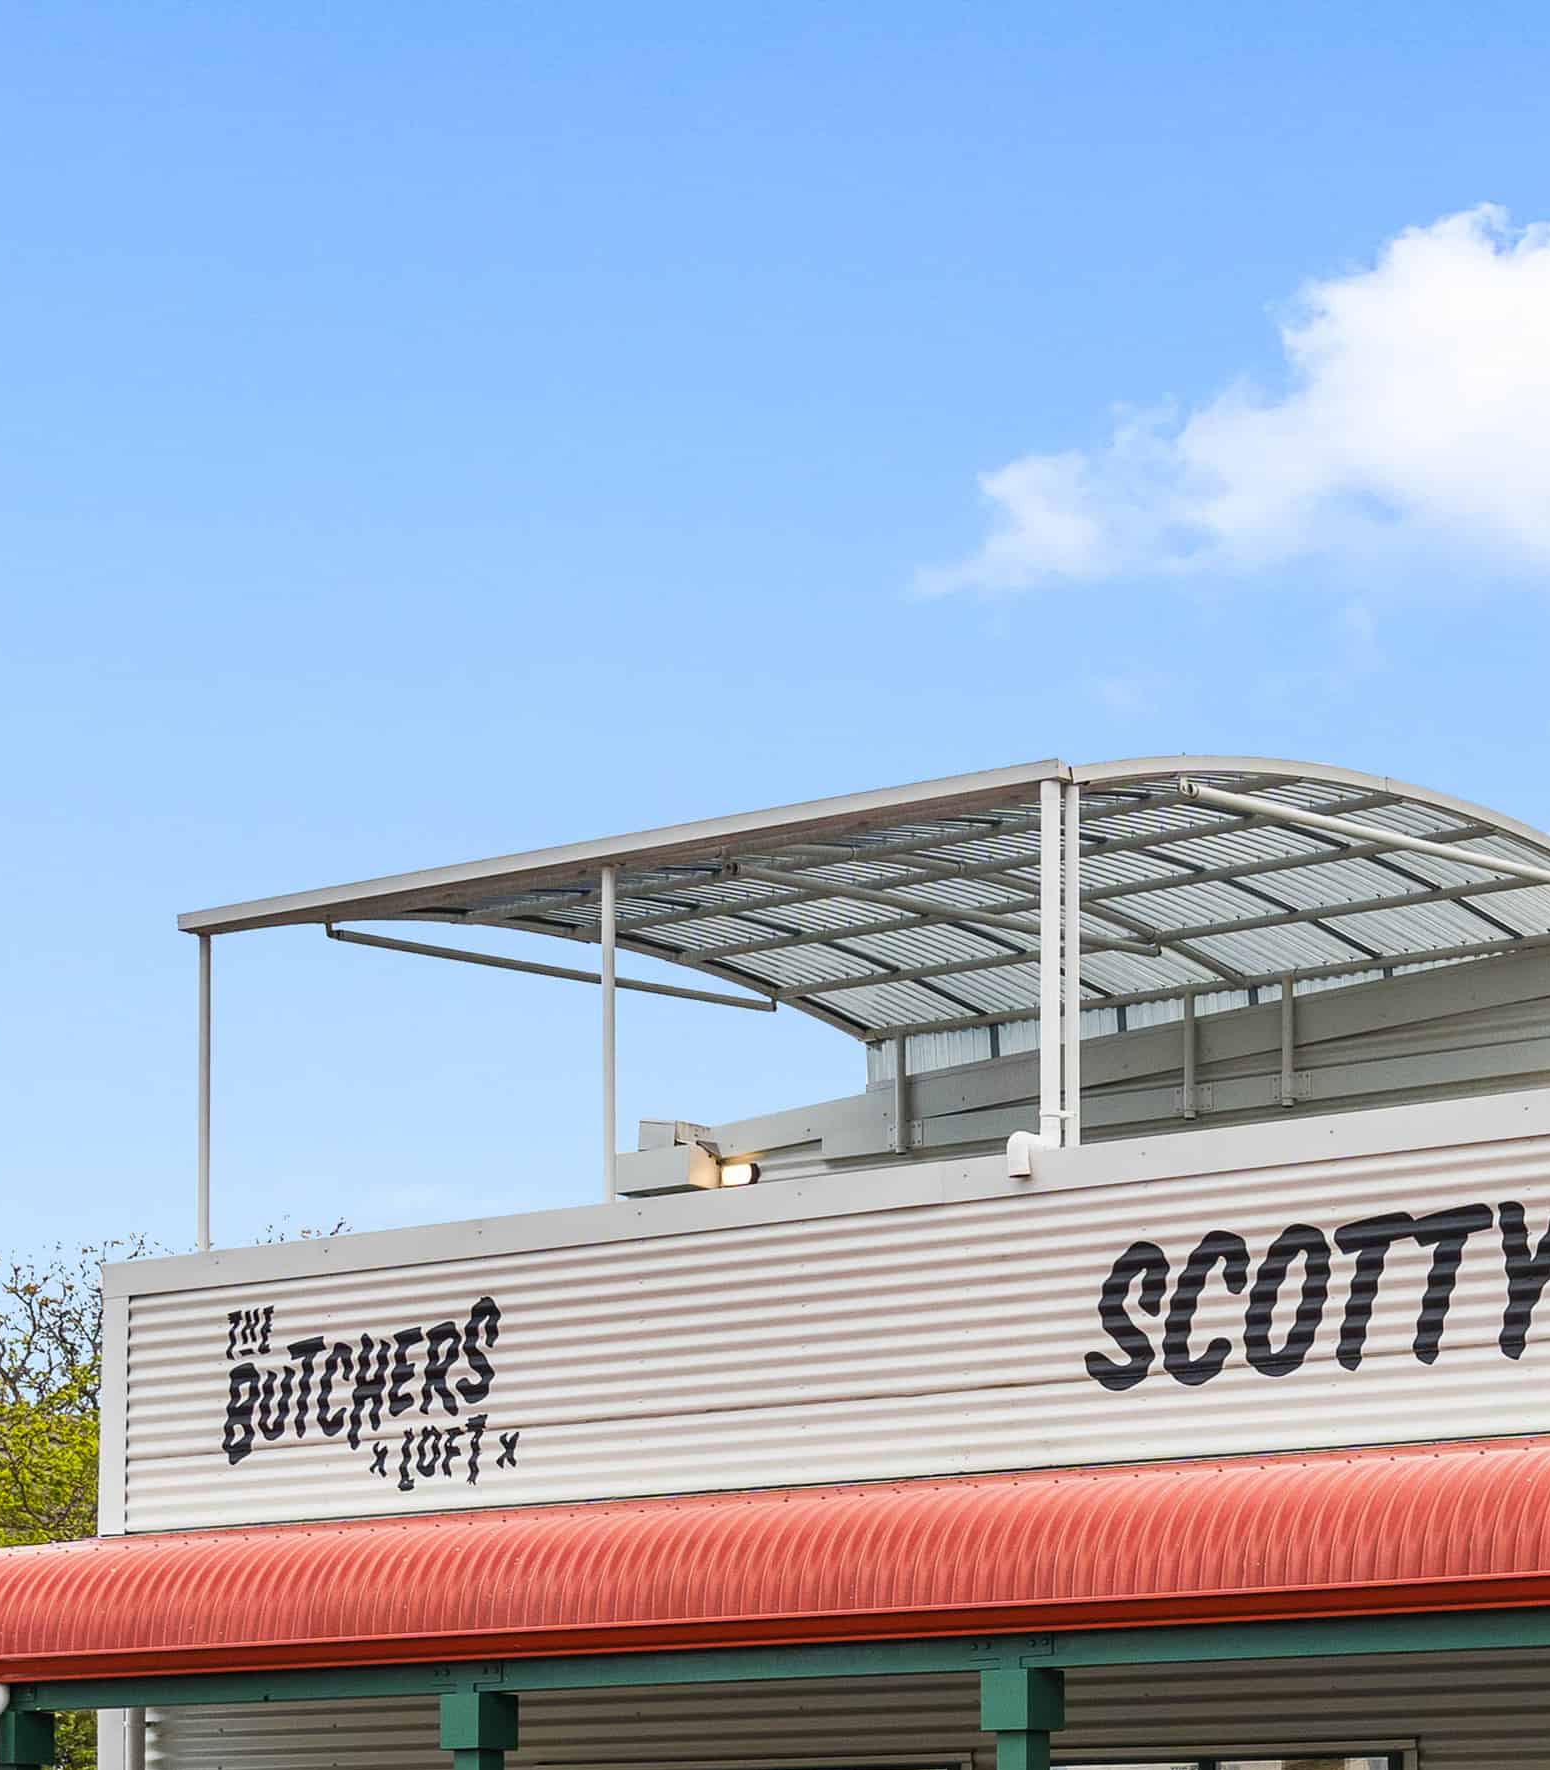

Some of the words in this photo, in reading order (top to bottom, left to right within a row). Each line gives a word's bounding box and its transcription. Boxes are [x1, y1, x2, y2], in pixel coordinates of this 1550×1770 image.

[226, 1306, 274, 1358] THE
[222, 1296, 501, 1465] BUTCHERS
[399, 1413, 489, 1492] LOFT
